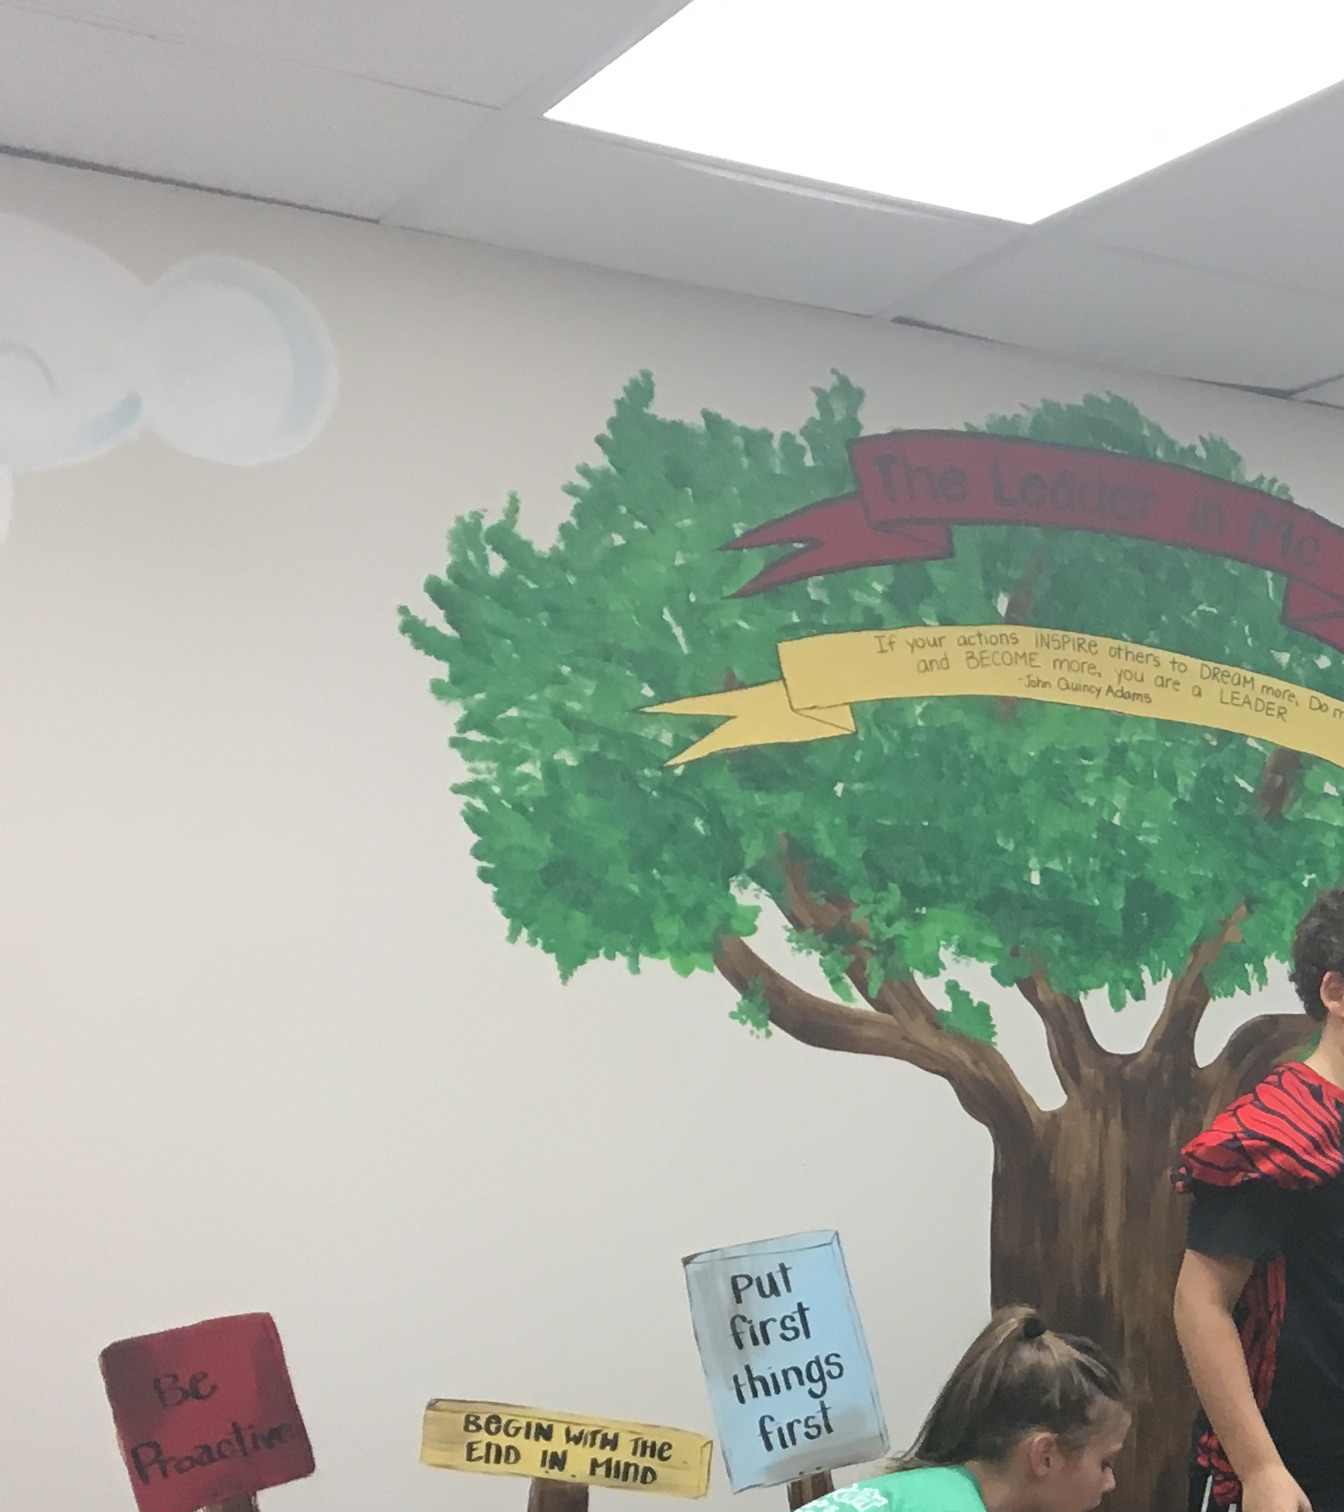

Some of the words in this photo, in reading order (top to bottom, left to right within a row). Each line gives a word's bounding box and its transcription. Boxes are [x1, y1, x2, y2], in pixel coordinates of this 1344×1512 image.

[871, 452, 968, 504] The
[1249, 506, 1321, 568] Me
[873, 634, 898, 654] If
[904, 634, 947, 653] your
[956, 630, 1020, 647] actions
[1107, 643, 1161, 669] others
[1169, 655, 1188, 674] to
[1308, 695, 1329, 714] Do
[916, 652, 951, 674] and
[964, 650, 1042, 671] BECOME
[1113, 667, 1145, 686] you
[1153, 673, 1182, 693] are
[1191, 684, 1203, 699] a
[1219, 688, 1289, 723] LEADER
[1057, 676, 1103, 699] Quincy
[1105, 684, 1153, 705] Adams
[729, 1262, 793, 1305] Put
[729, 1301, 811, 1351] first
[152, 1371, 218, 1409] Be
[730, 1352, 844, 1405] things
[563, 1425, 620, 1452] WITH
[757, 1400, 834, 1453] first
[130, 1420, 294, 1485] Proactive
[539, 1449, 568, 1473] IN
